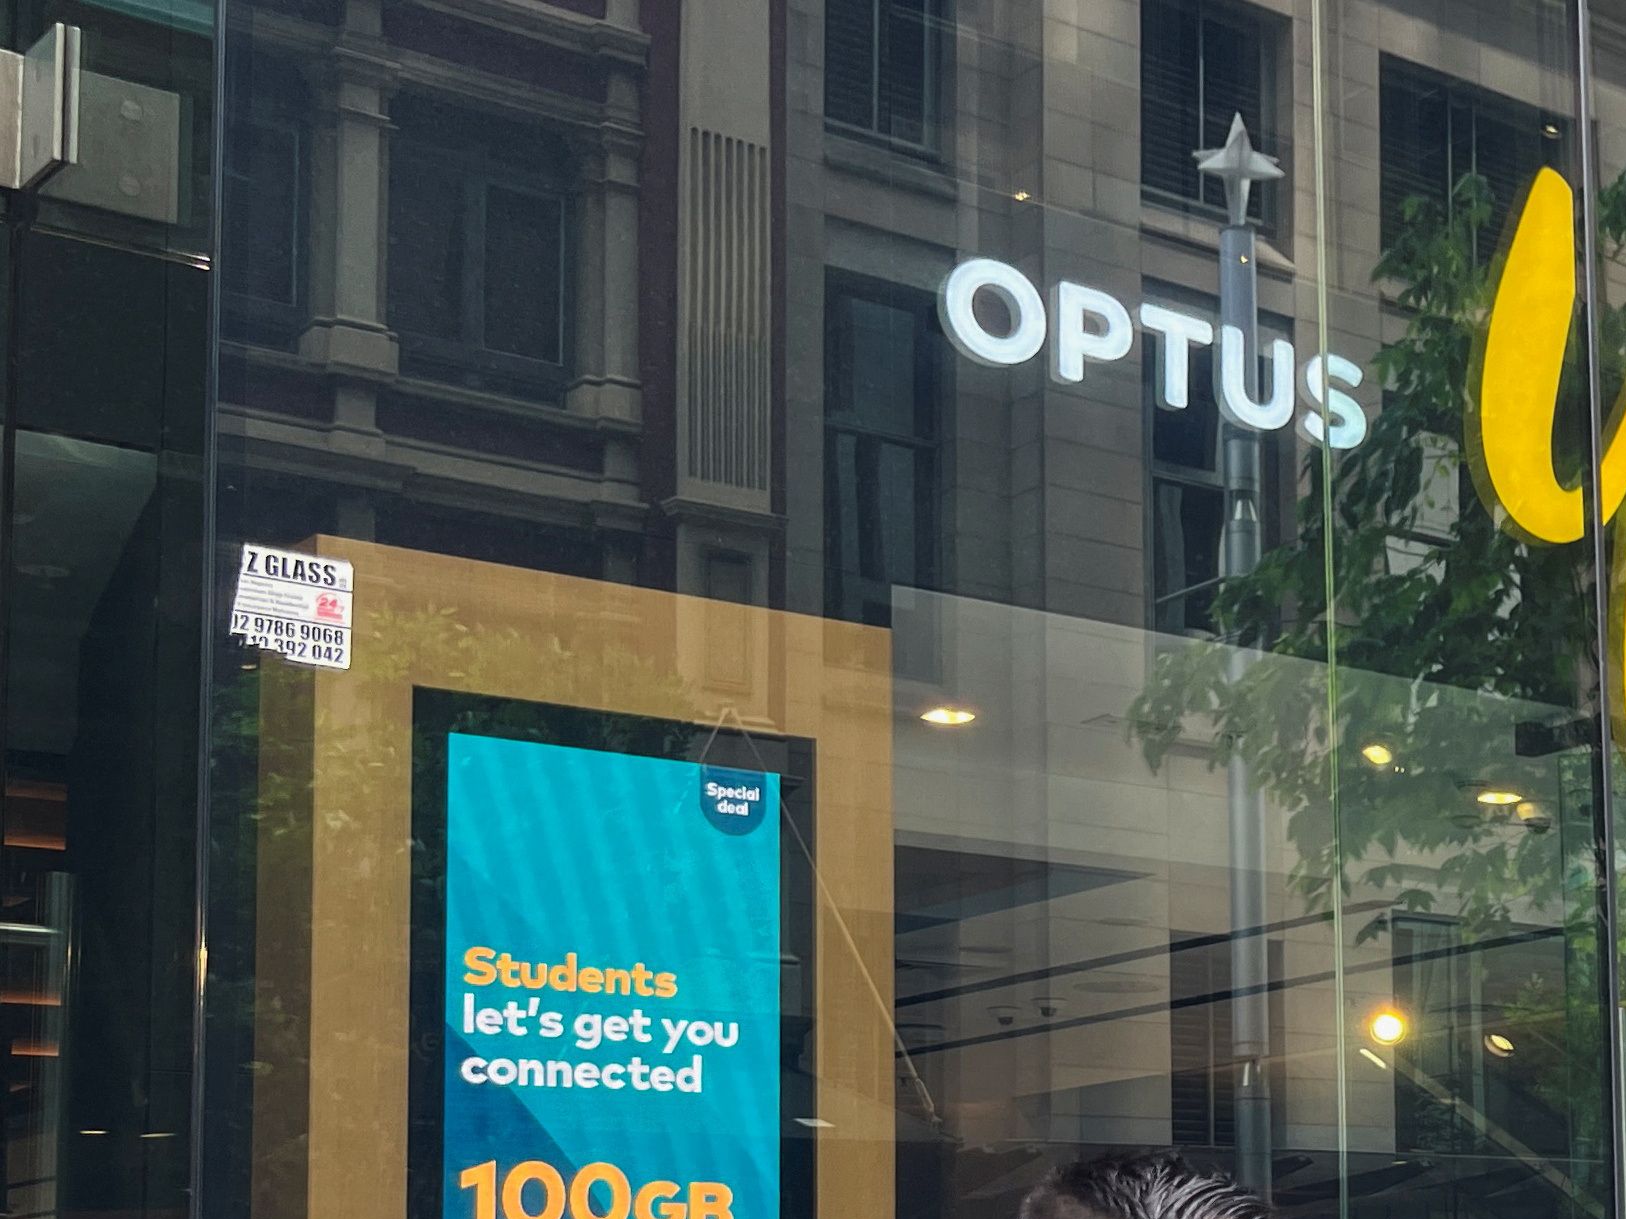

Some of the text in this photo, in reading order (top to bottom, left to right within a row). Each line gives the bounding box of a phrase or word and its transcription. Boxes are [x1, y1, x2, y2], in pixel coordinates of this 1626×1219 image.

[939, 257, 1369, 450] OPTUS
[264, 554, 337, 587] GLASS
[254, 617, 296, 638] 9786
[300, 624, 344, 647] 9068
[312, 644, 344, 664] 042
[705, 782, 760, 801] Special
[717, 799, 749, 816] deal
[463, 945, 678, 999] Students
[463, 992, 740, 1054] let's get you
[460, 1054, 703, 1093] connected
